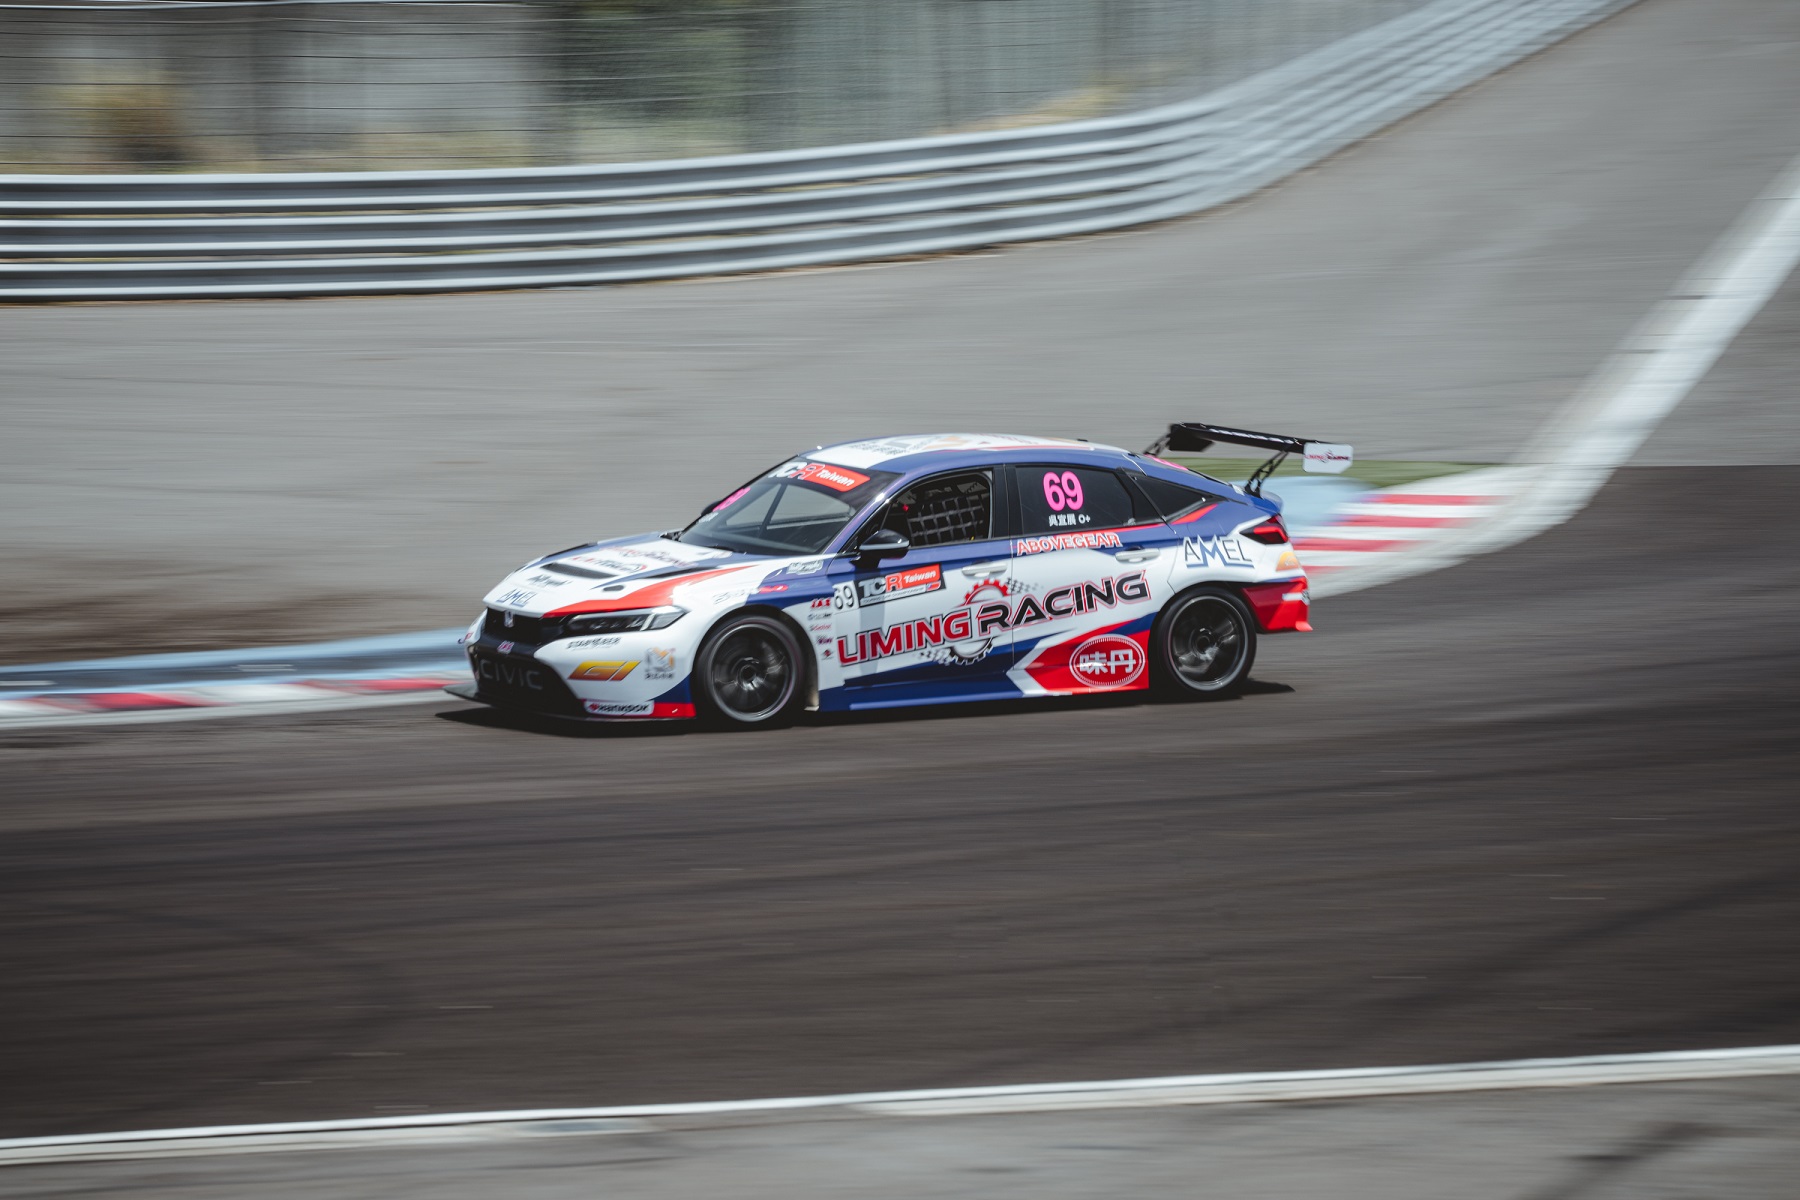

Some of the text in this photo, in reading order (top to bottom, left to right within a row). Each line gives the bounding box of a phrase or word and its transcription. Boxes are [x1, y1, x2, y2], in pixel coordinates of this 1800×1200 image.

[815, 469, 855, 487] Taiwan
[1043, 471, 1084, 512] 69
[1017, 532, 1123, 556] ABOVEGEAR
[1183, 535, 1255, 569] AMEL
[834, 585, 855, 610] 69
[858, 570, 937, 598] TCR Taiwan
[836, 571, 1151, 667] LIMING RACING
[480, 659, 543, 690] CIVIC
[1079, 648, 1137, 675] 味丹
